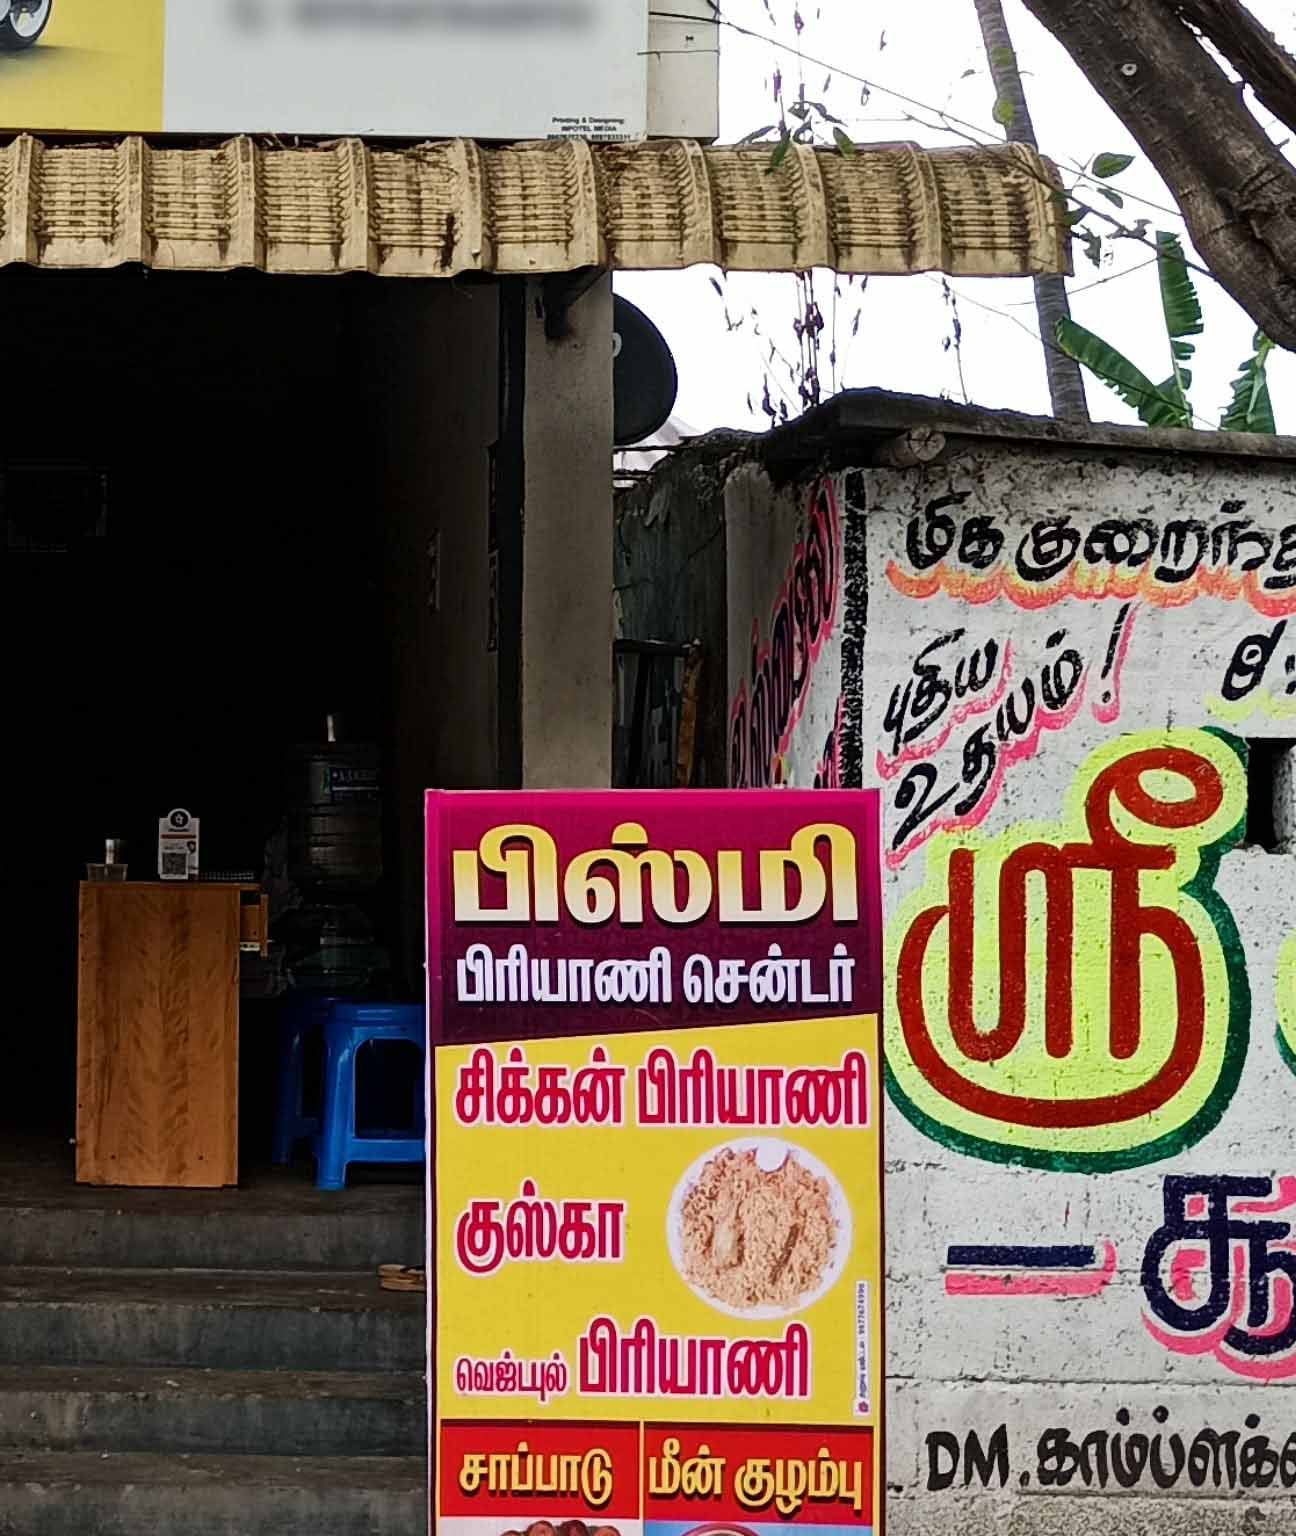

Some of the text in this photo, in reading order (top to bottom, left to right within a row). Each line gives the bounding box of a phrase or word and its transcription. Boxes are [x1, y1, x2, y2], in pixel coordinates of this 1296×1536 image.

[452, 822, 859, 924] பிஸ்மி
[457, 942, 856, 1004] பிரியாணி சென்டர்
[455, 1047, 869, 1126] சிக்கன் பிரியாணி
[456, 1179, 625, 1272] குஸ்கா
[579, 1317, 809, 1396] பிரியாணி
[459, 1438, 863, 1511] சாப்பாடு மீன் குழம்பு
